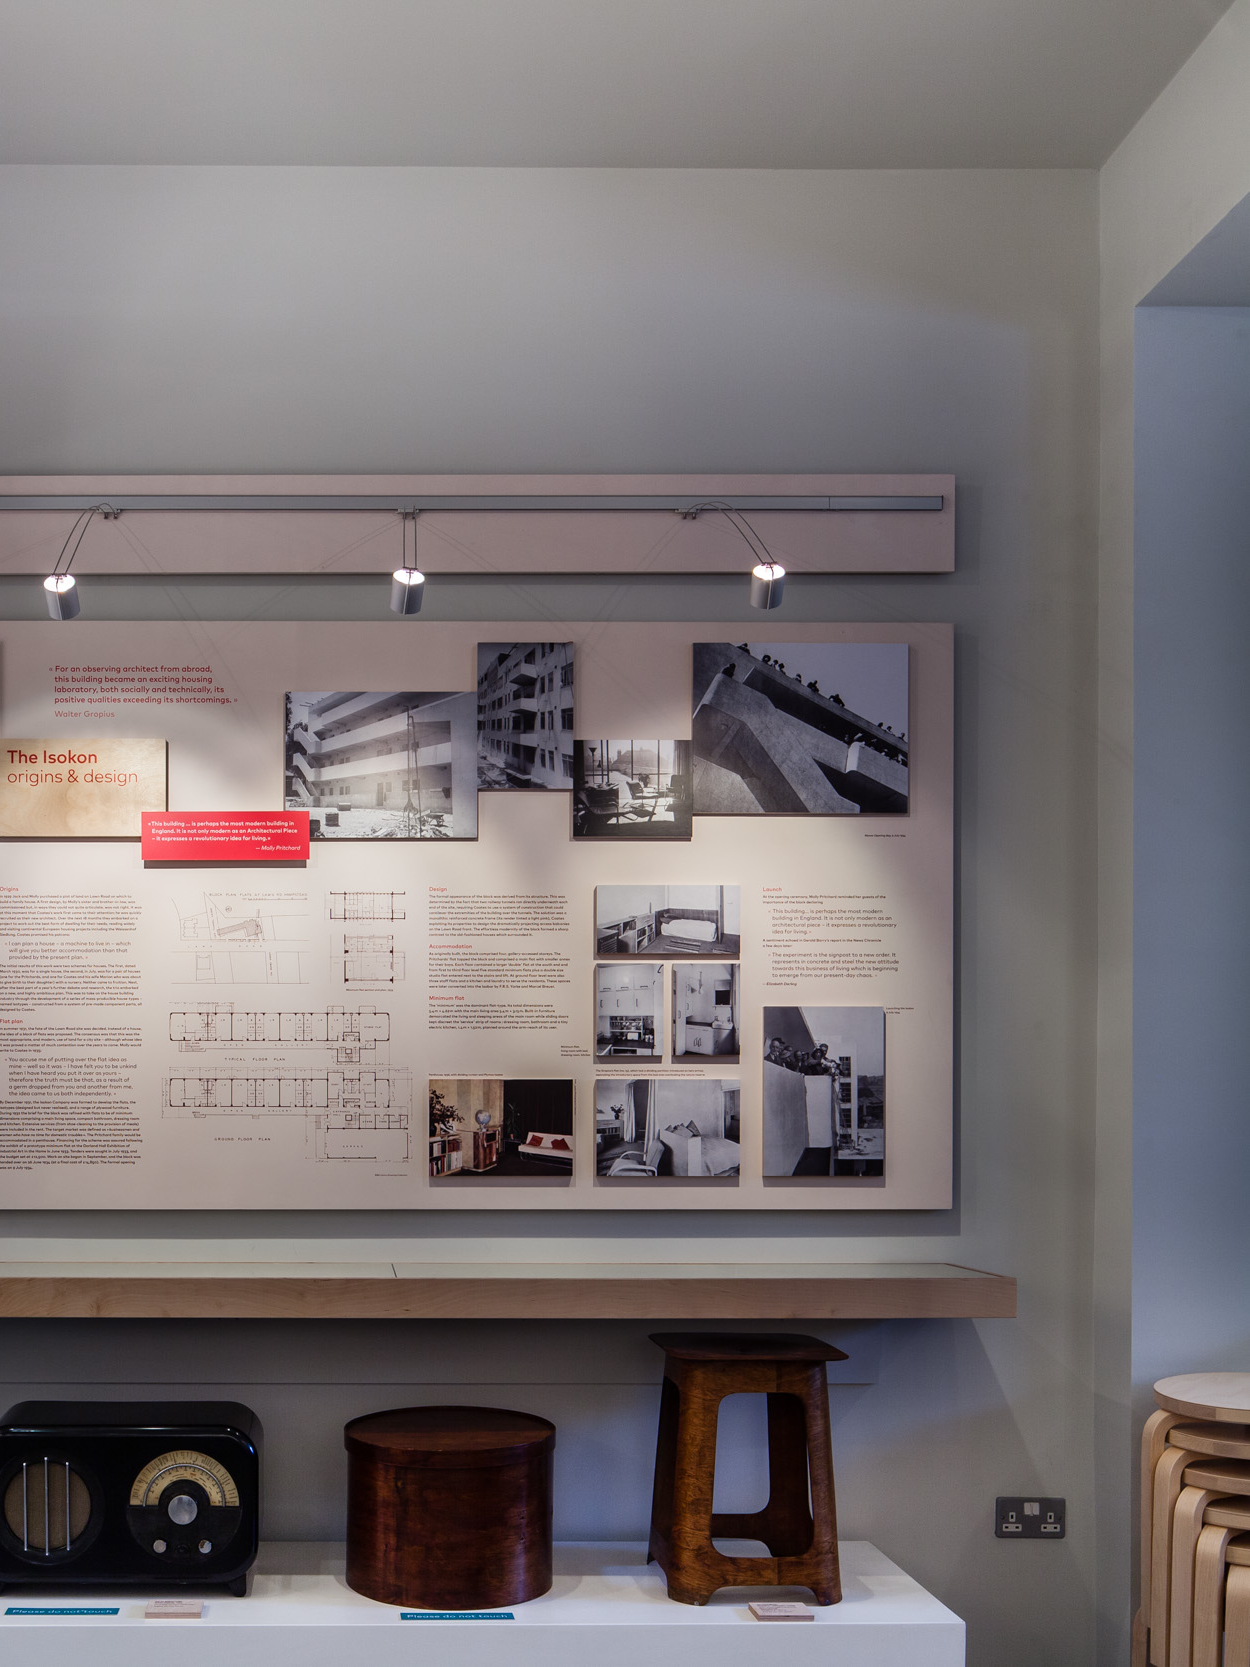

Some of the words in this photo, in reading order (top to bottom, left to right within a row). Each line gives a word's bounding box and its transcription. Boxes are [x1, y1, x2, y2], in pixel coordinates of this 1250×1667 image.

[54, 665, 69, 673] For
[81, 665, 122, 675] observing
[122, 665, 159, 673] architect
[160, 664, 180, 673] from
[181, 665, 213, 674] abroad,
[54, 675, 70, 683] this
[71, 675, 103, 685] building
[104, 675, 136, 683] became
[148, 675, 180, 685] exciting
[181, 675, 213, 685] housing
[54, 685, 99, 695] laboratory,
[100, 685, 119, 694] both
[120, 685, 151, 695] socially
[151, 685, 167, 694] and
[168, 685, 213, 695] technically,
[214, 685, 225, 694] its
[54, 695, 86, 705] positive
[87, 695, 122, 705] qualities
[122, 695, 162, 705] exceeding
[163, 695, 174, 704] its
[175, 695, 232, 705] shortcomings.
[54, 710, 82, 718] Walter
[83, 710, 116, 720] Gropius
[6, 749, 38, 764] The
[43, 750, 97, 764] Isokon
[6, 768, 63, 787] origins
[67, 768, 79, 784] &
[83, 769, 138, 787] design
